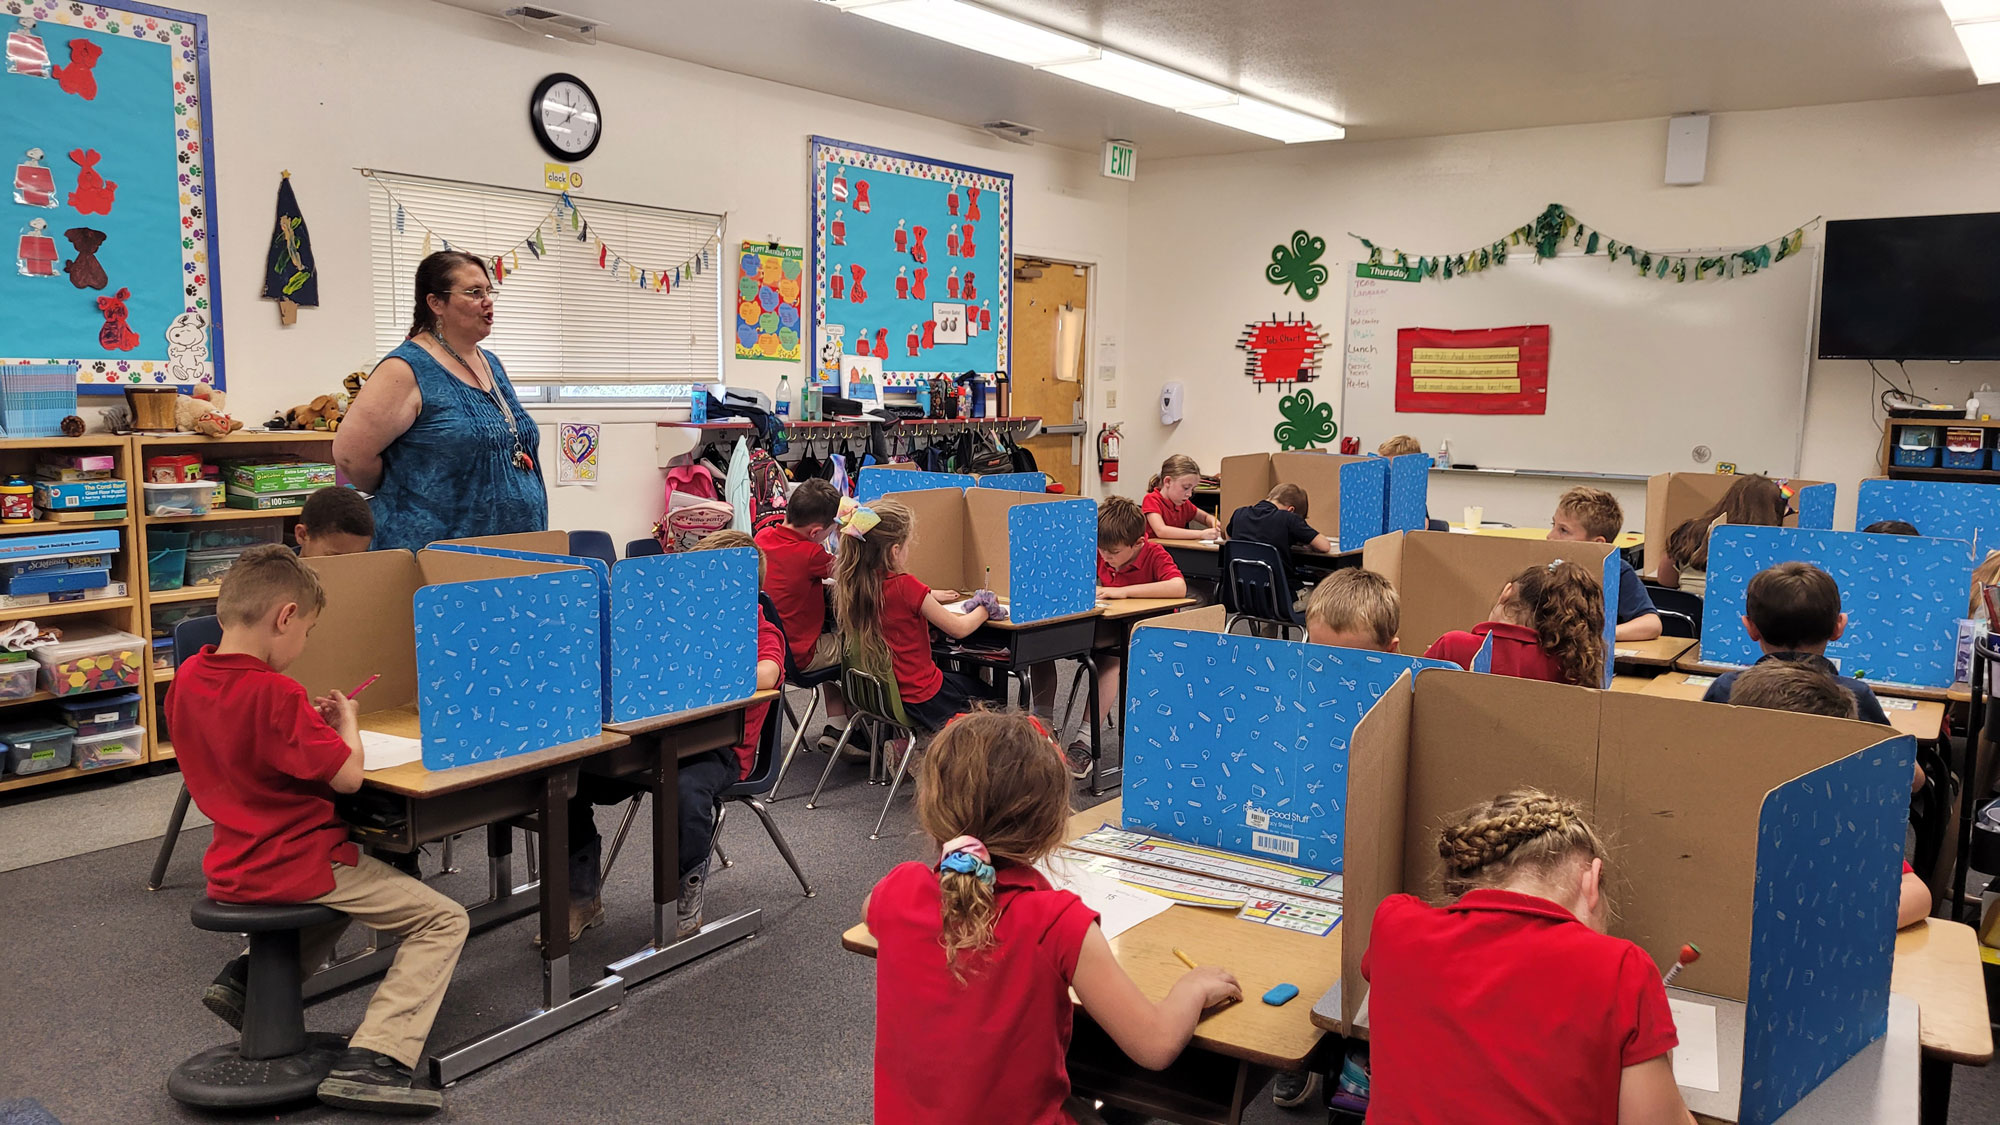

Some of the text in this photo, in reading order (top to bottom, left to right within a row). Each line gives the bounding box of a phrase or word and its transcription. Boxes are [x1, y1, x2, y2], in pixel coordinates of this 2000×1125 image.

[1111, 145, 1133, 176] EXIT
[548, 171, 566, 183] clock
[1369, 267, 1409, 280] Thursday
[1265, 332, 1300, 345] Job Chart
[1347, 344, 1378, 354] Lunch
[271, 498, 282, 506] 100
[1267, 808, 1291, 820] Good
[1291, 812, 1310, 823] Stuff
[1278, 821, 1293, 830] Shield
